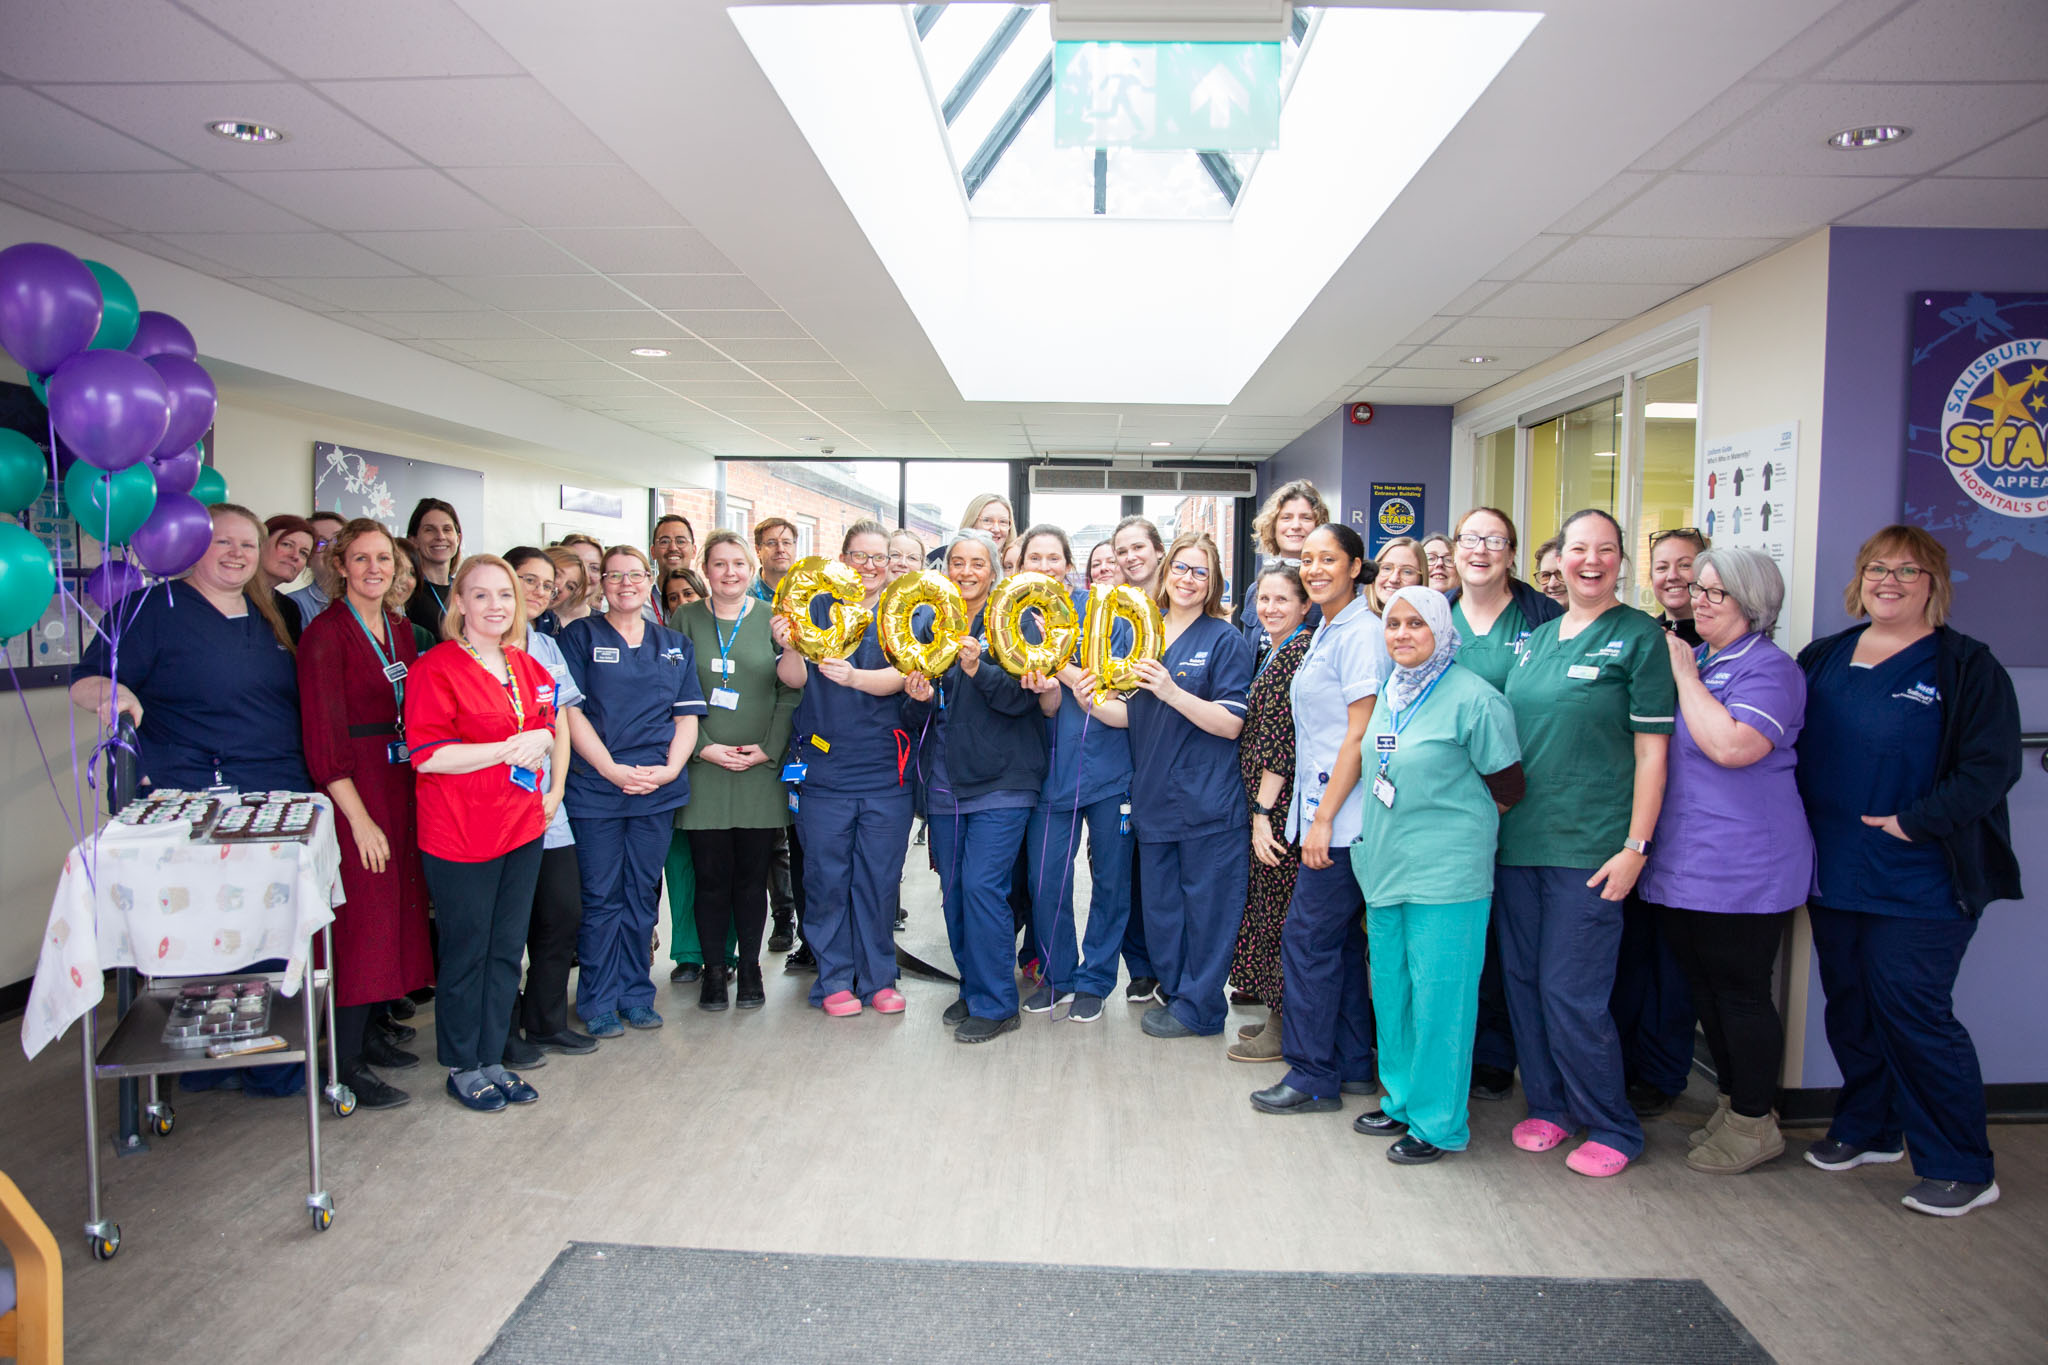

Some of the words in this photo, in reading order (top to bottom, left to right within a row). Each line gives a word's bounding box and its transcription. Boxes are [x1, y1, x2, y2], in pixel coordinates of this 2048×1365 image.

[1947, 341, 2042, 414] SALISBURY
[1948, 425, 2048, 466] STA
[1959, 469, 2033, 513] HOSPITAL'S
[1380, 515, 1414, 524] STARS
[772, 555, 1166, 700] GOOD
